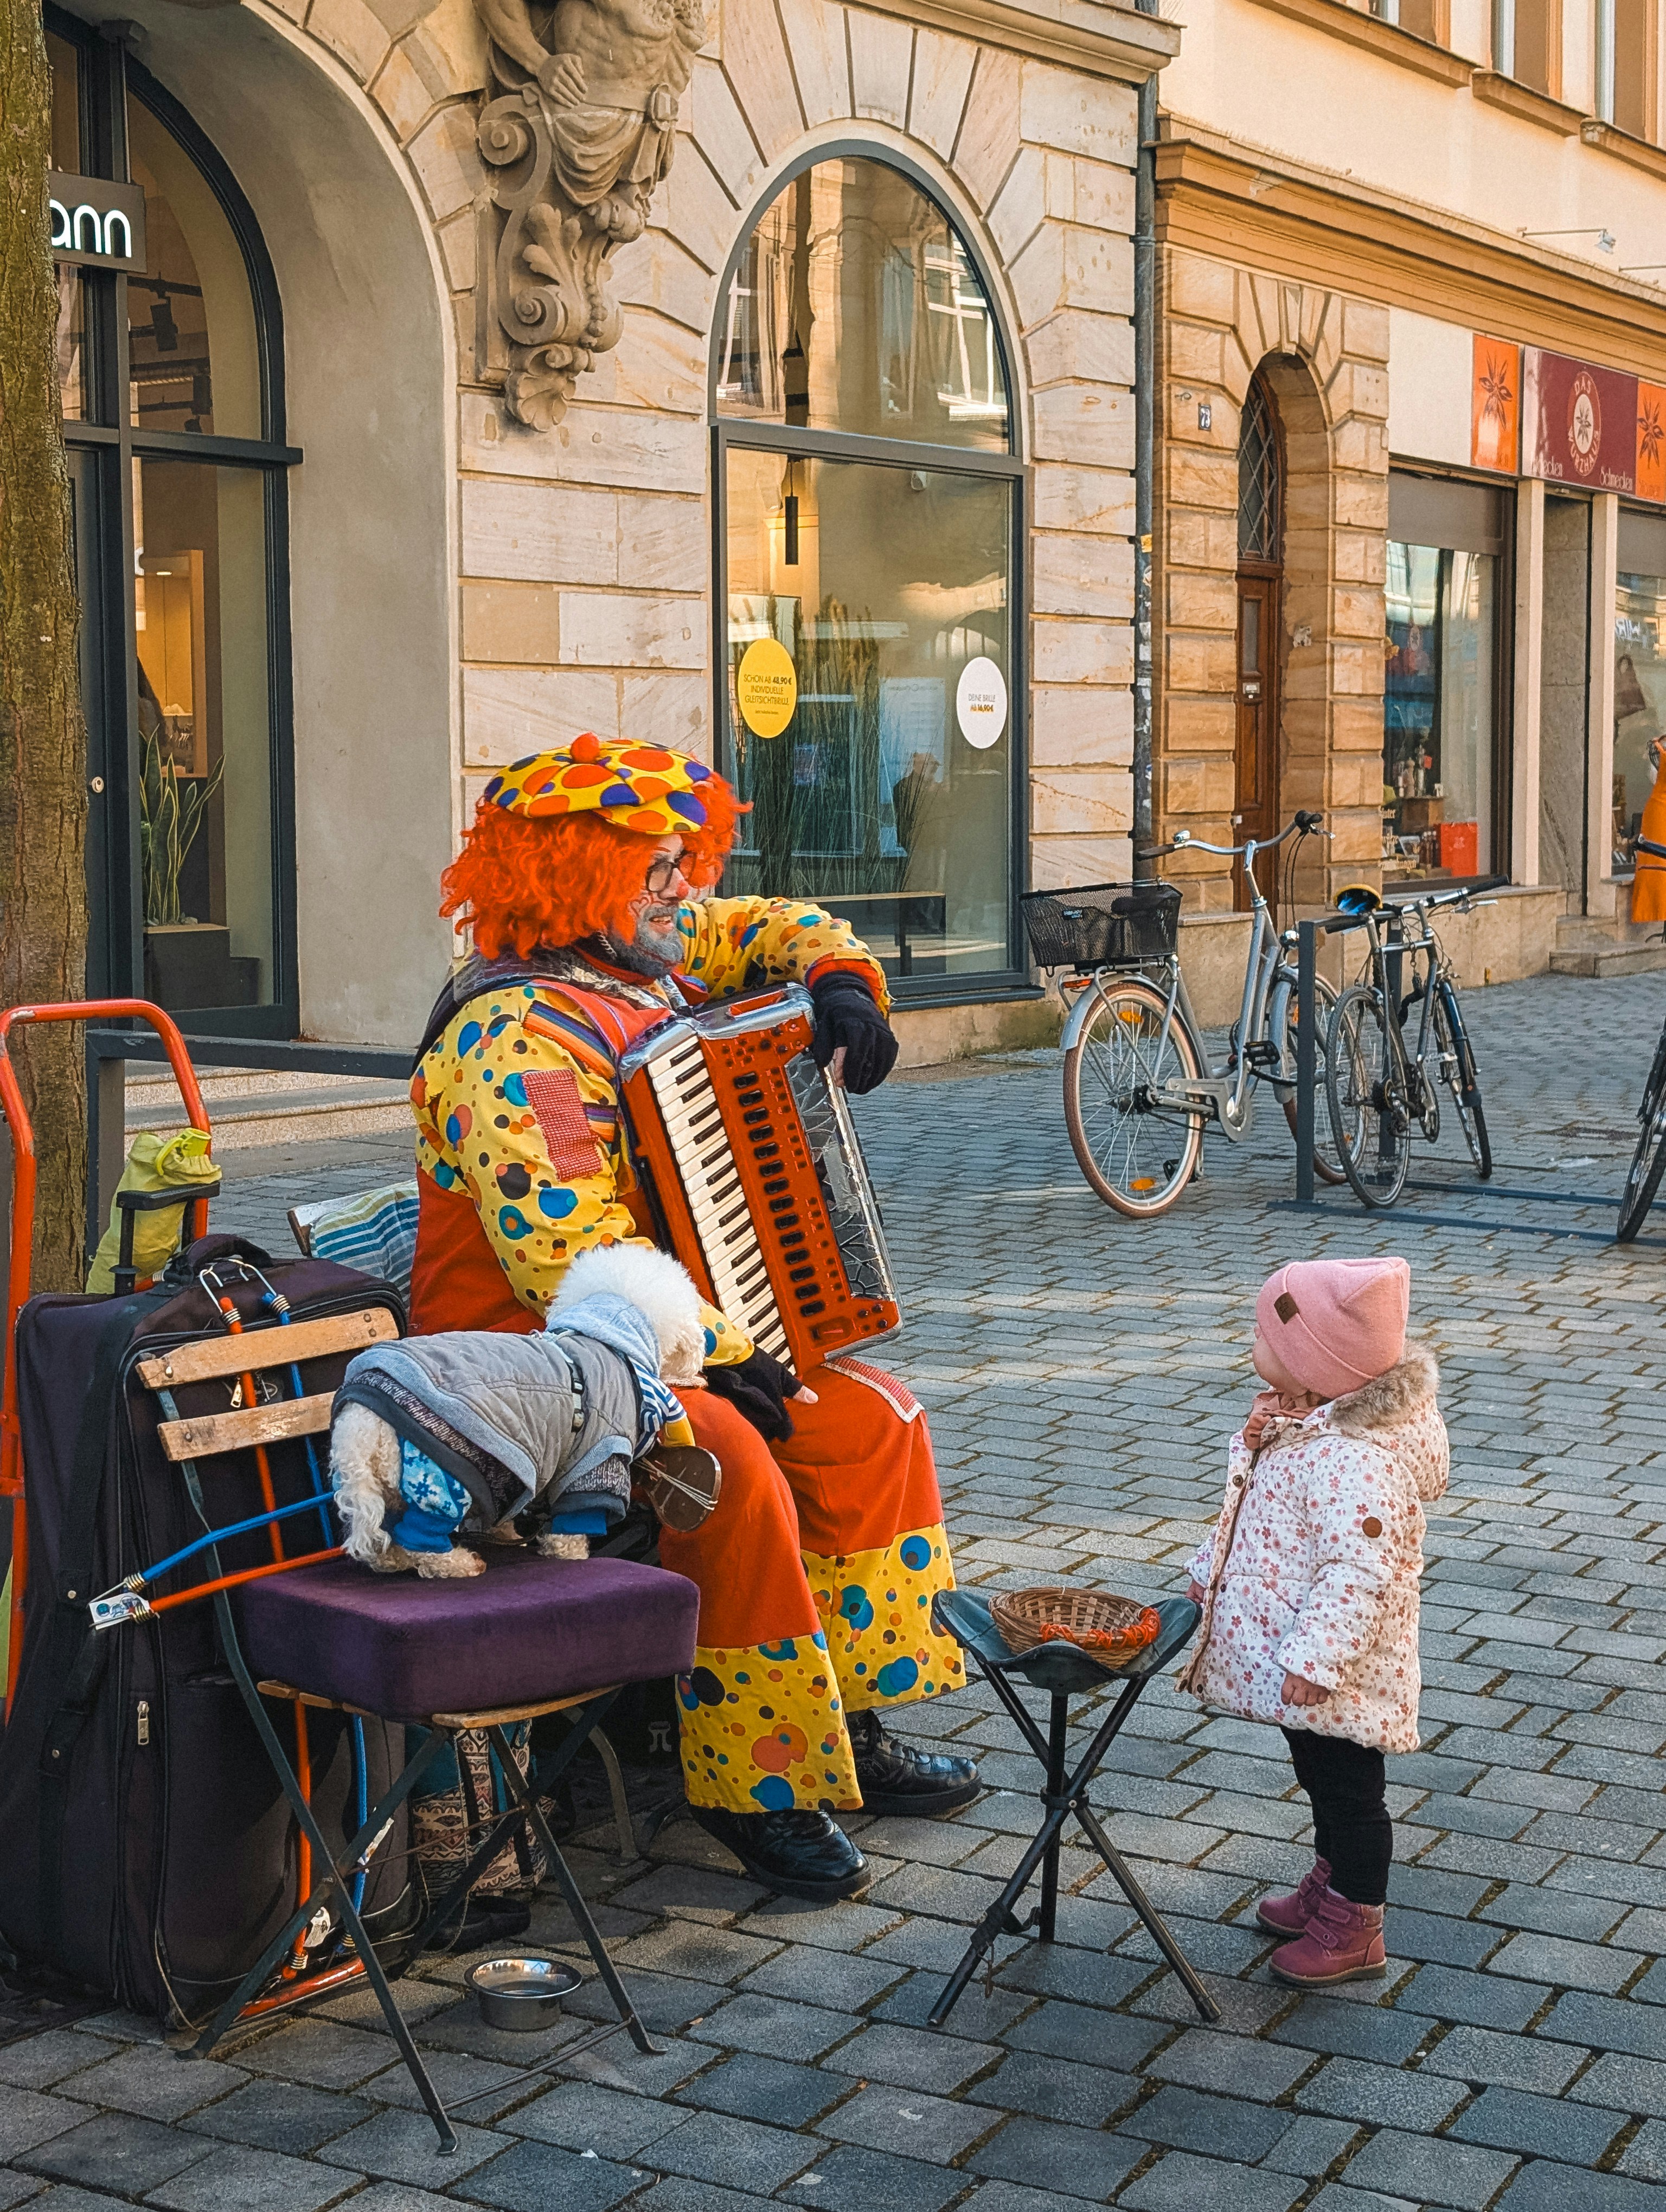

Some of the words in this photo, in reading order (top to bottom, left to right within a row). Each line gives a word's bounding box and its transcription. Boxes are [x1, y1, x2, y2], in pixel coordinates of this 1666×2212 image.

[1574, 376, 1591, 395] DAS
[744, 674, 763, 683] SCHON
[751, 685, 784, 695] INDIVIDUELLE
[745, 695, 789, 705] GLEITSICHTBRILLE
